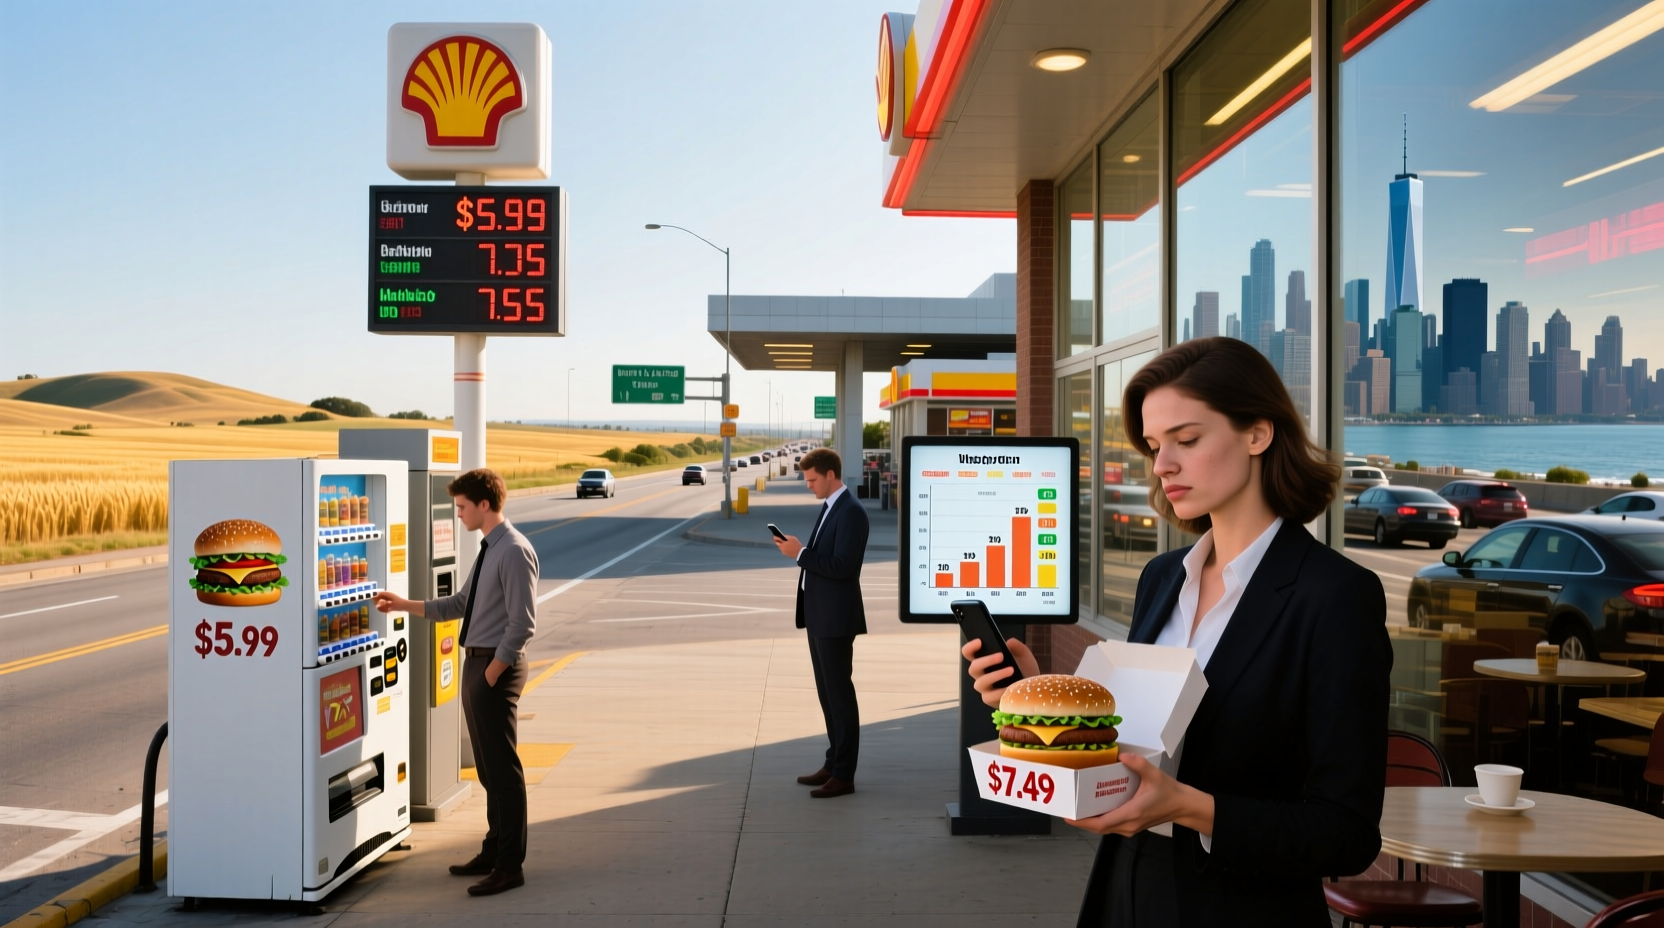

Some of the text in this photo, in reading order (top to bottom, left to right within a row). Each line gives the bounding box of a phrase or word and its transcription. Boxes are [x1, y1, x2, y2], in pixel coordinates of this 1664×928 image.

[456, 195, 546, 232] $5.99
[478, 287, 545, 322] 7.55
[194, 619, 279, 659] $5.99
[987, 759, 1056, 805] $7.49
